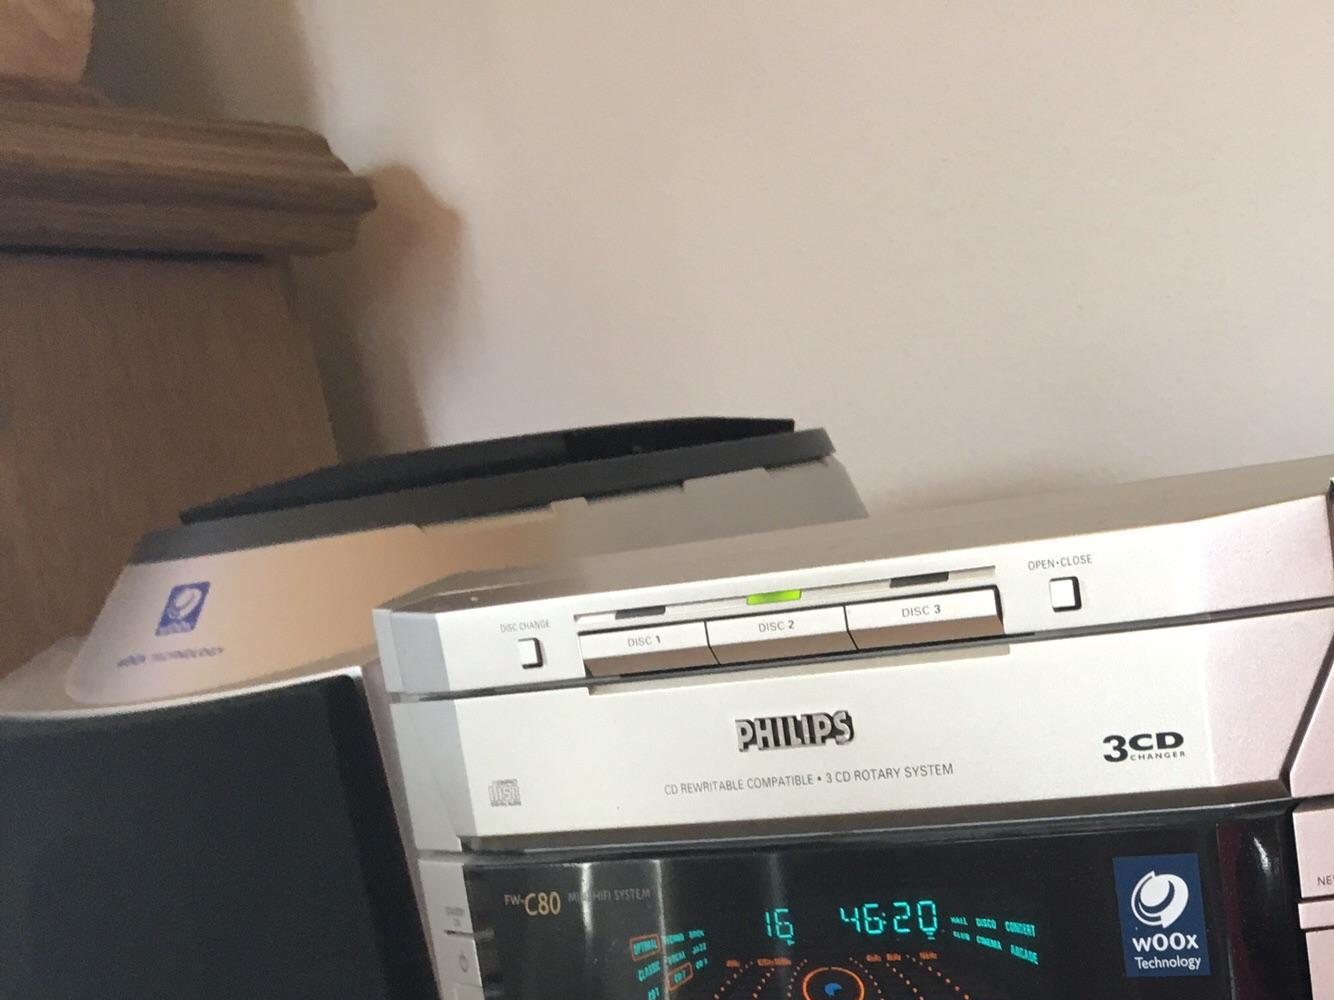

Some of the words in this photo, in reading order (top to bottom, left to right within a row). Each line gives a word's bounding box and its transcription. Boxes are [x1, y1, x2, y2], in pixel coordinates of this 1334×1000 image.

[901, 605, 930, 618] DISC
[934, 604, 942, 615] 3
[500, 622, 518, 633] DISC
[519, 619, 550, 631] CHANGE
[758, 621, 784, 633] DISC
[787, 619, 795, 631] 2
[627, 635, 652, 648] DISC
[655, 634, 662, 645] 1
[735, 710, 855, 752] PHILIPS
[1102, 731, 1185, 763] 3CD
[1130, 751, 1186, 761] CHANGER
[664, 783, 679, 796] CD
[680, 777, 744, 795] REWRITABLE
[746, 773, 814, 790] COMPATIBLE
[825, 772, 833, 784] 3
[835, 771, 852, 784] CD
[854, 767, 901, 782] ROTARY
[903, 763, 954, 778] SYSTEM
[764, 907, 795, 940] 16
[839, 899, 939, 936] 46:20
[1134, 955, 1202, 972] Technology
